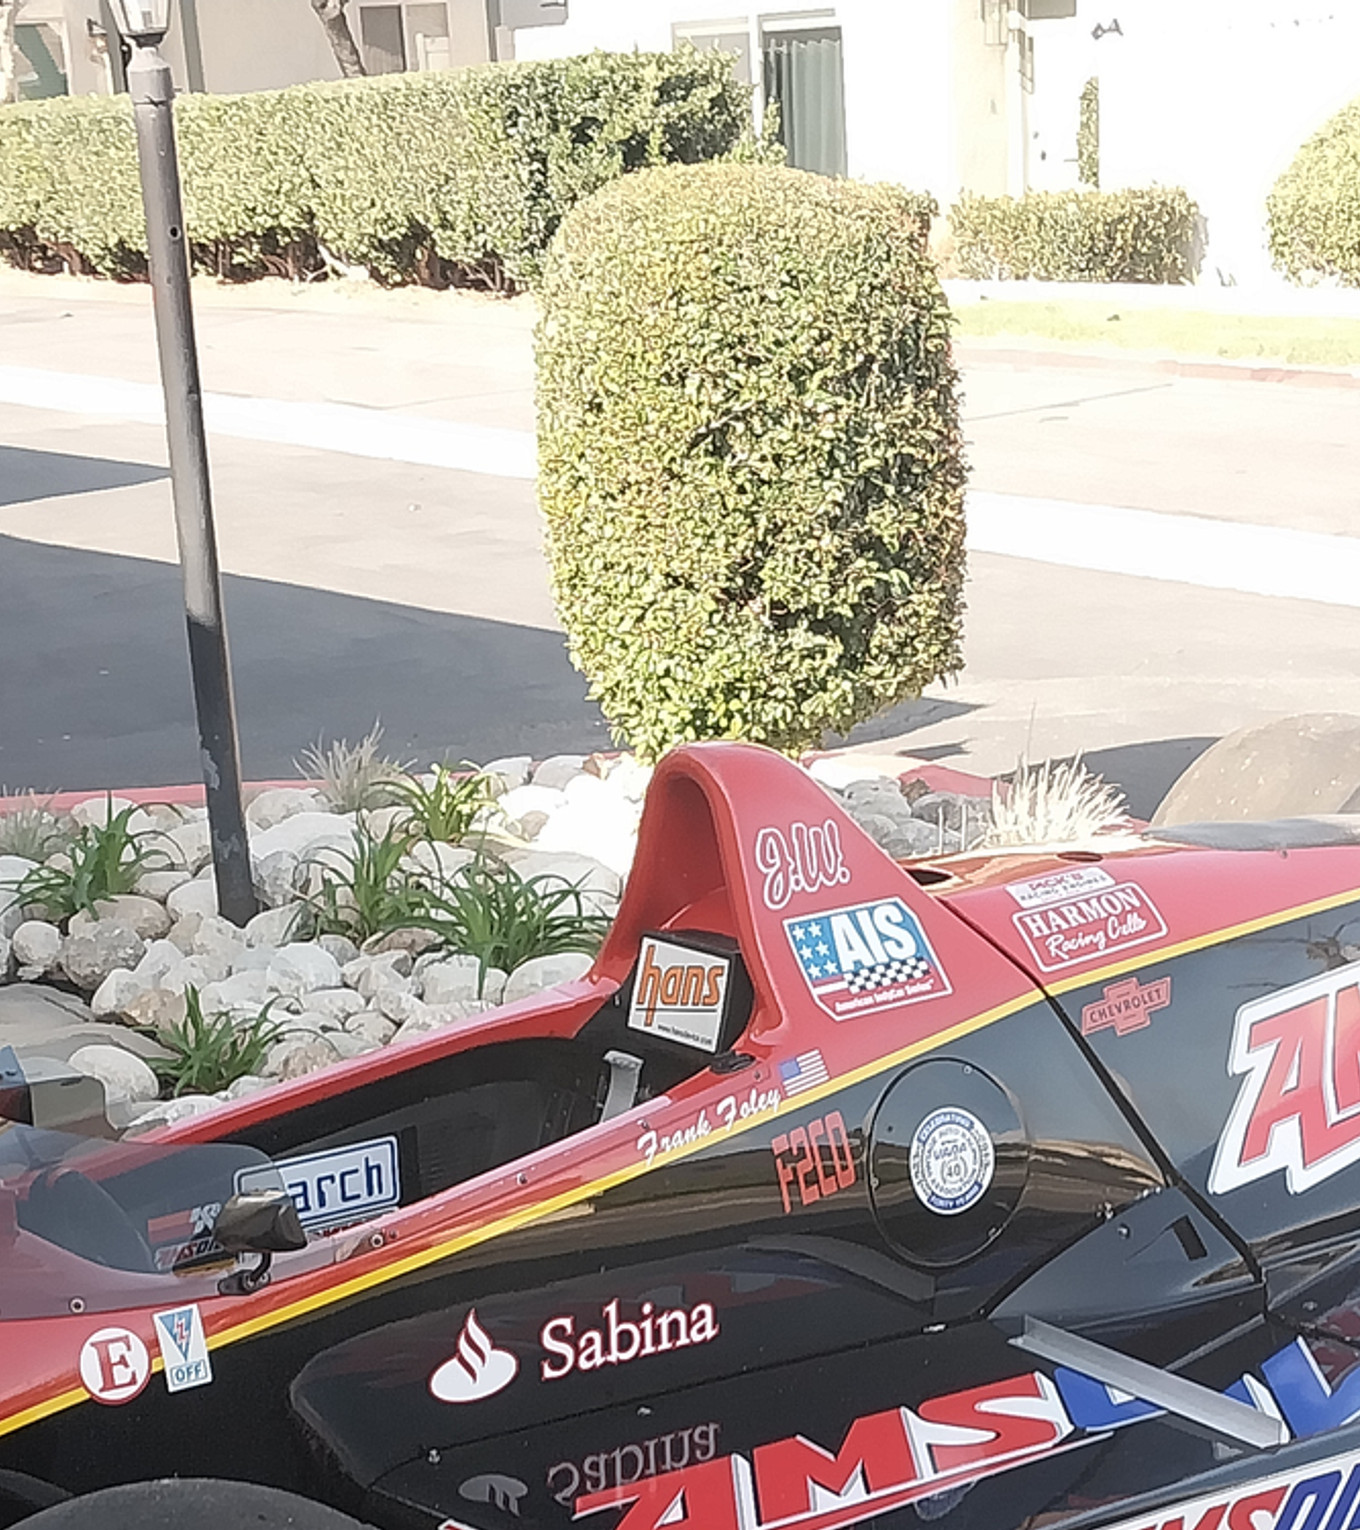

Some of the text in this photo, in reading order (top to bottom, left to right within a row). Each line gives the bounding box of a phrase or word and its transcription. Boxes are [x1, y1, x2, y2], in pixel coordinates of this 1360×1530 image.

[830, 902, 918, 973] AIS
[1022, 888, 1142, 938] HARMON
[1044, 911, 1148, 961] Racing Cells
[635, 944, 725, 1027] hans
[1089, 987, 1163, 1025] CHEVROLET
[636, 1087, 782, 1167] Frank Foley
[288, 1156, 386, 1214] arch
[88, 1334, 139, 1394] E
[539, 1296, 721, 1382] Sabina
[174, 1362, 203, 1383] OFF
